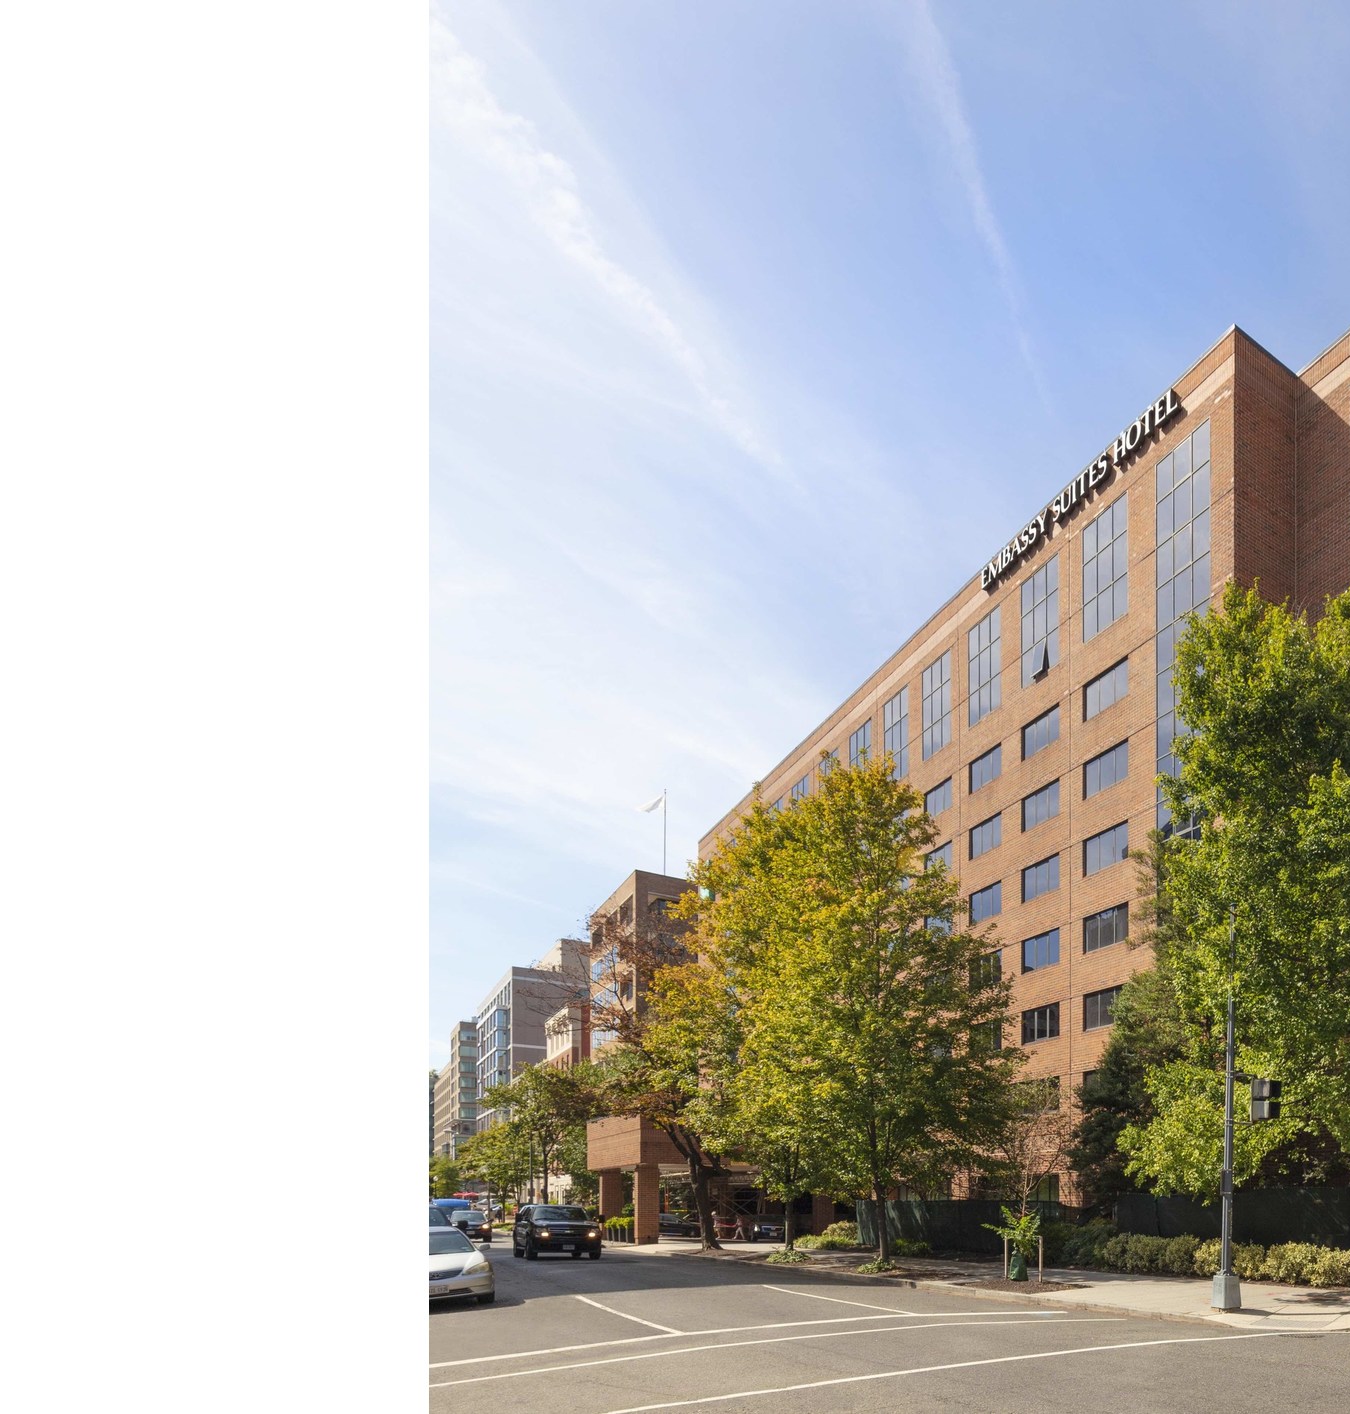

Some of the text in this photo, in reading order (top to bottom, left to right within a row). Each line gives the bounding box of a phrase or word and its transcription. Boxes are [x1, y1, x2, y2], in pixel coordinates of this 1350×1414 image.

[981, 388, 1178, 589] EMBASSY SUITES HOTEL
